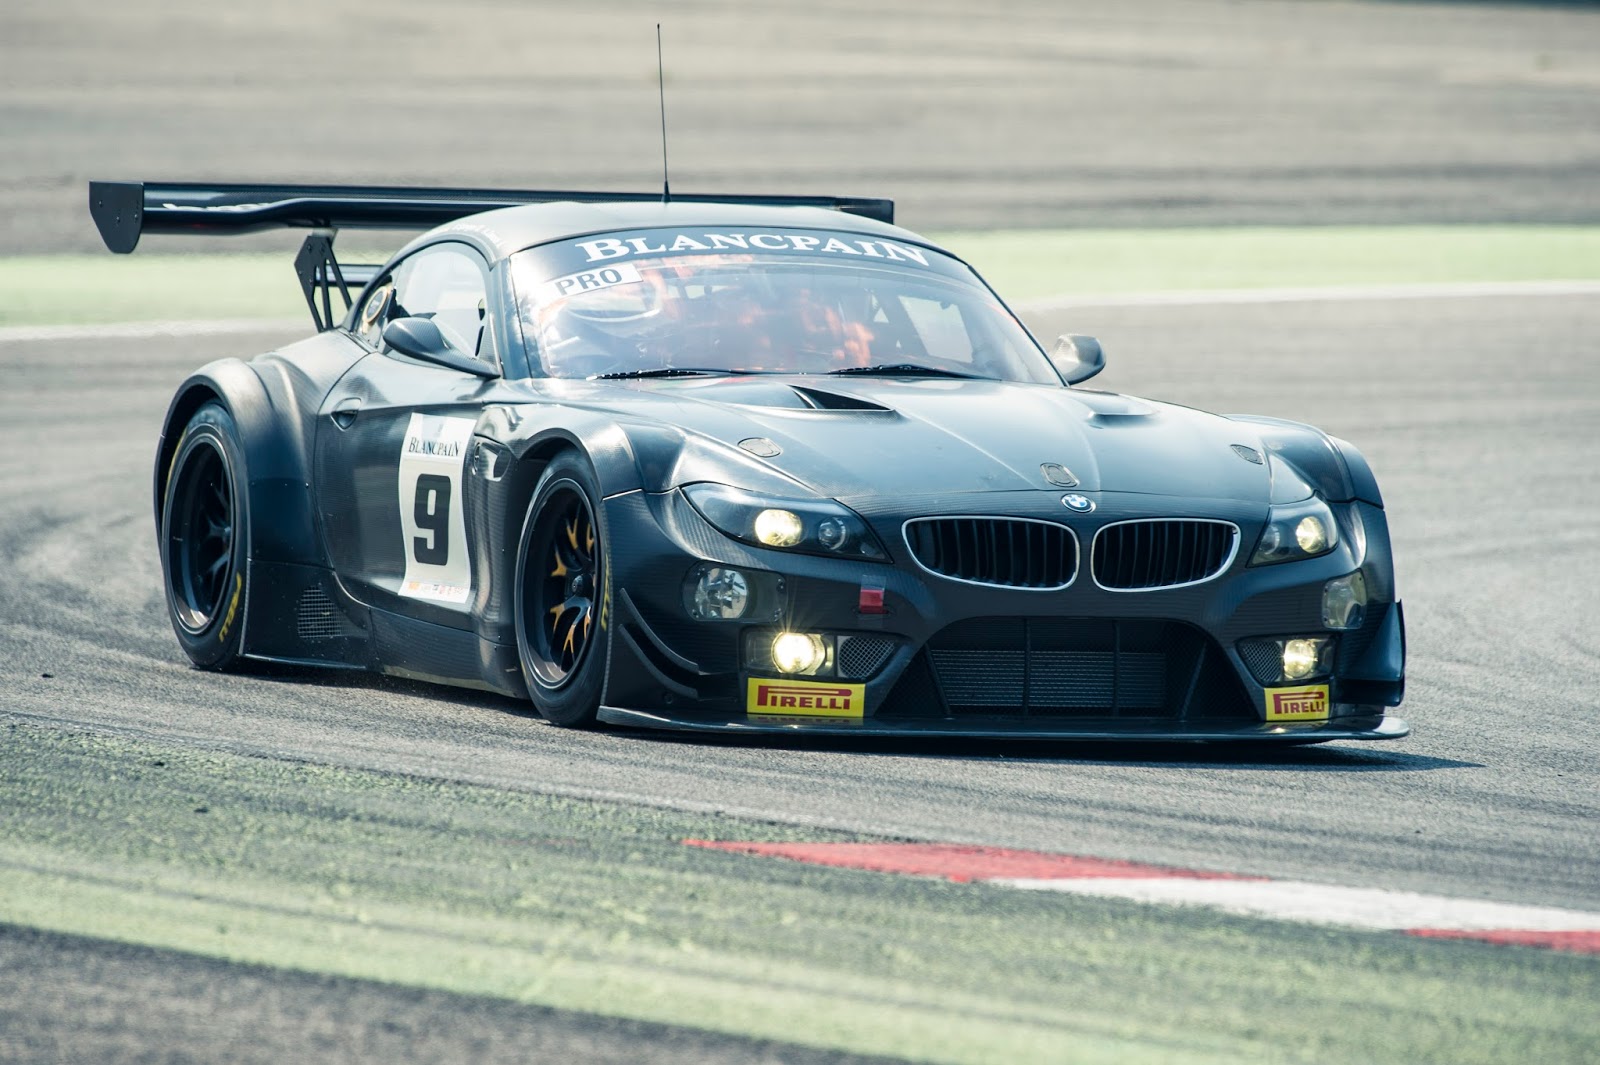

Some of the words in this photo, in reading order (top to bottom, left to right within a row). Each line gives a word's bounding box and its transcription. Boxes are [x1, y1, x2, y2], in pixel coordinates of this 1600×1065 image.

[576, 233, 930, 266] BLANCPAIN
[555, 267, 622, 296] PRO
[408, 437, 460, 457] BLANCPAIN
[413, 473, 451, 566] 9
[757, 685, 852, 710] PIRELLI
[1273, 691, 1325, 715] PIRELLI
